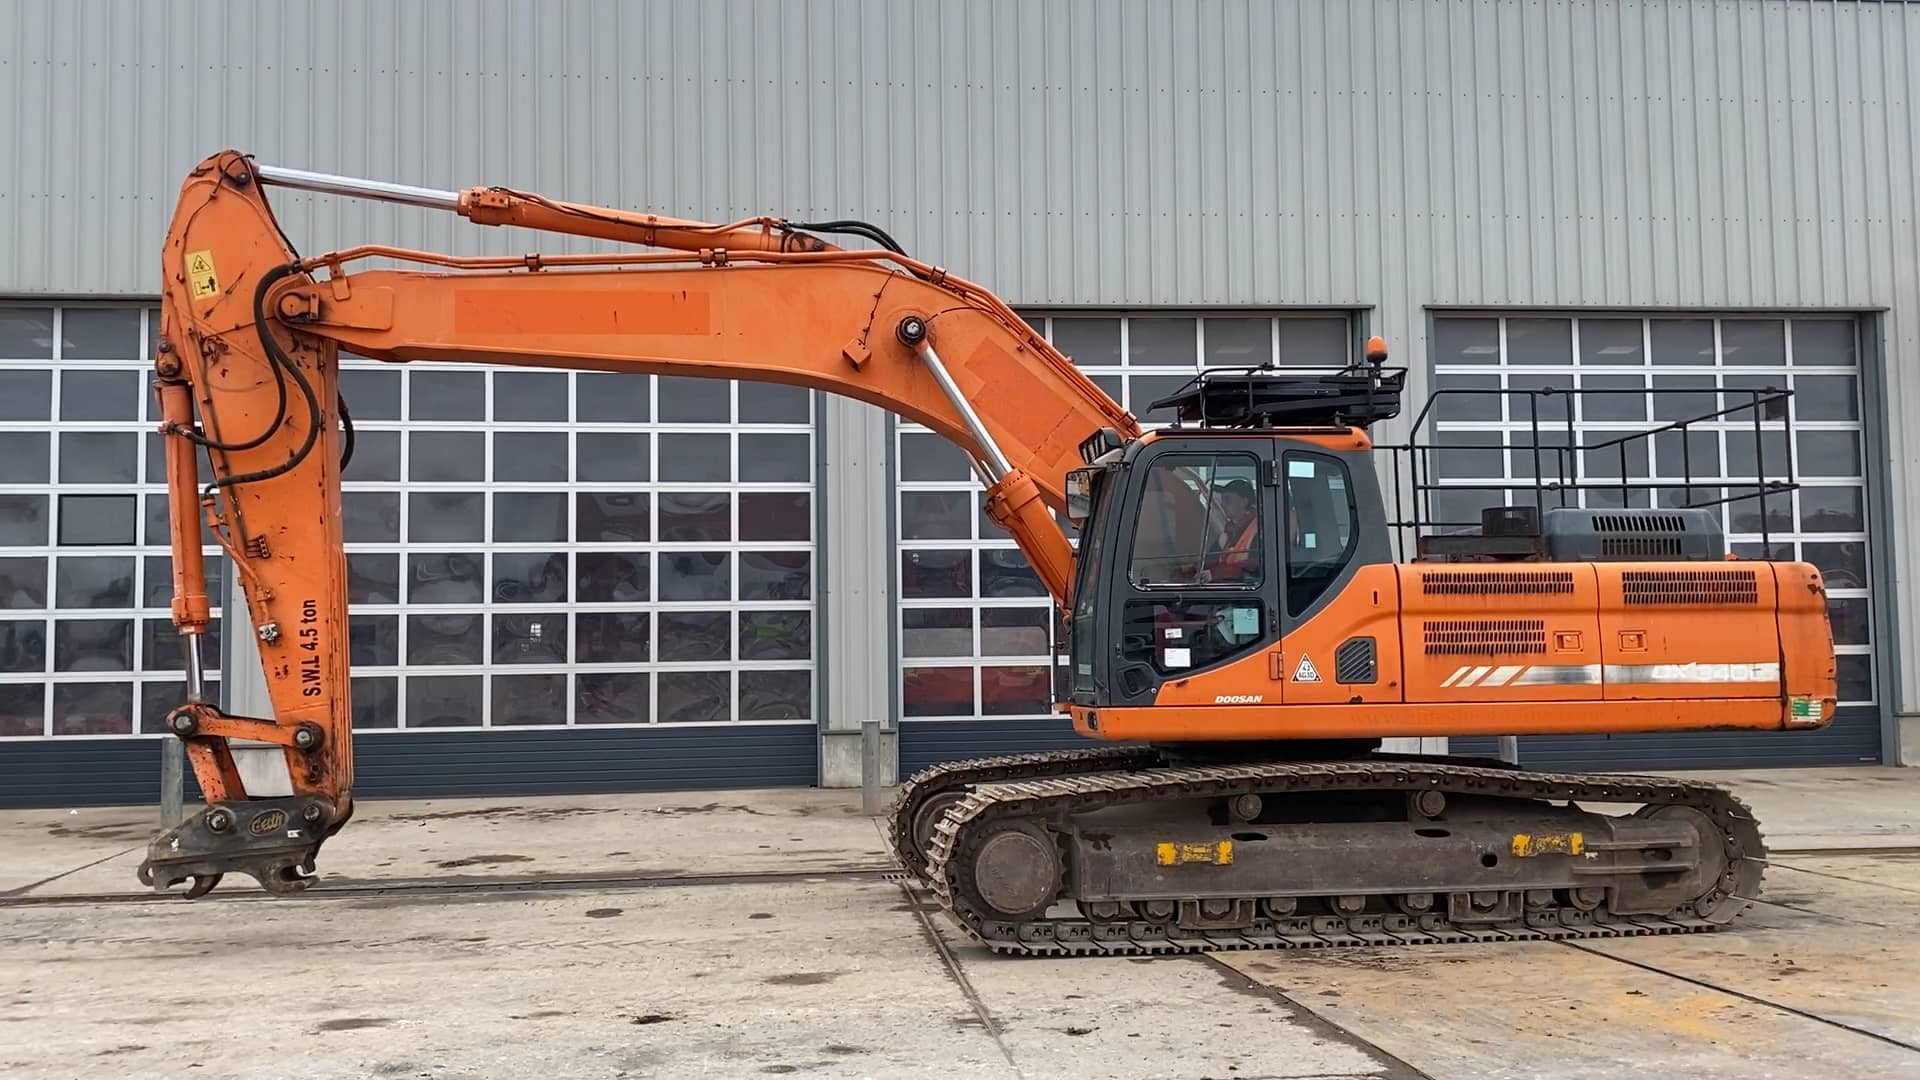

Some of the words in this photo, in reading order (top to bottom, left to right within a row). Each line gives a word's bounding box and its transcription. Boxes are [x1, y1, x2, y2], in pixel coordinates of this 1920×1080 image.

[300, 599, 317, 624] ton
[300, 628, 318, 651] 4.5
[301, 655, 321, 696] S.W.L
[1215, 695, 1263, 704] DOOSAN
